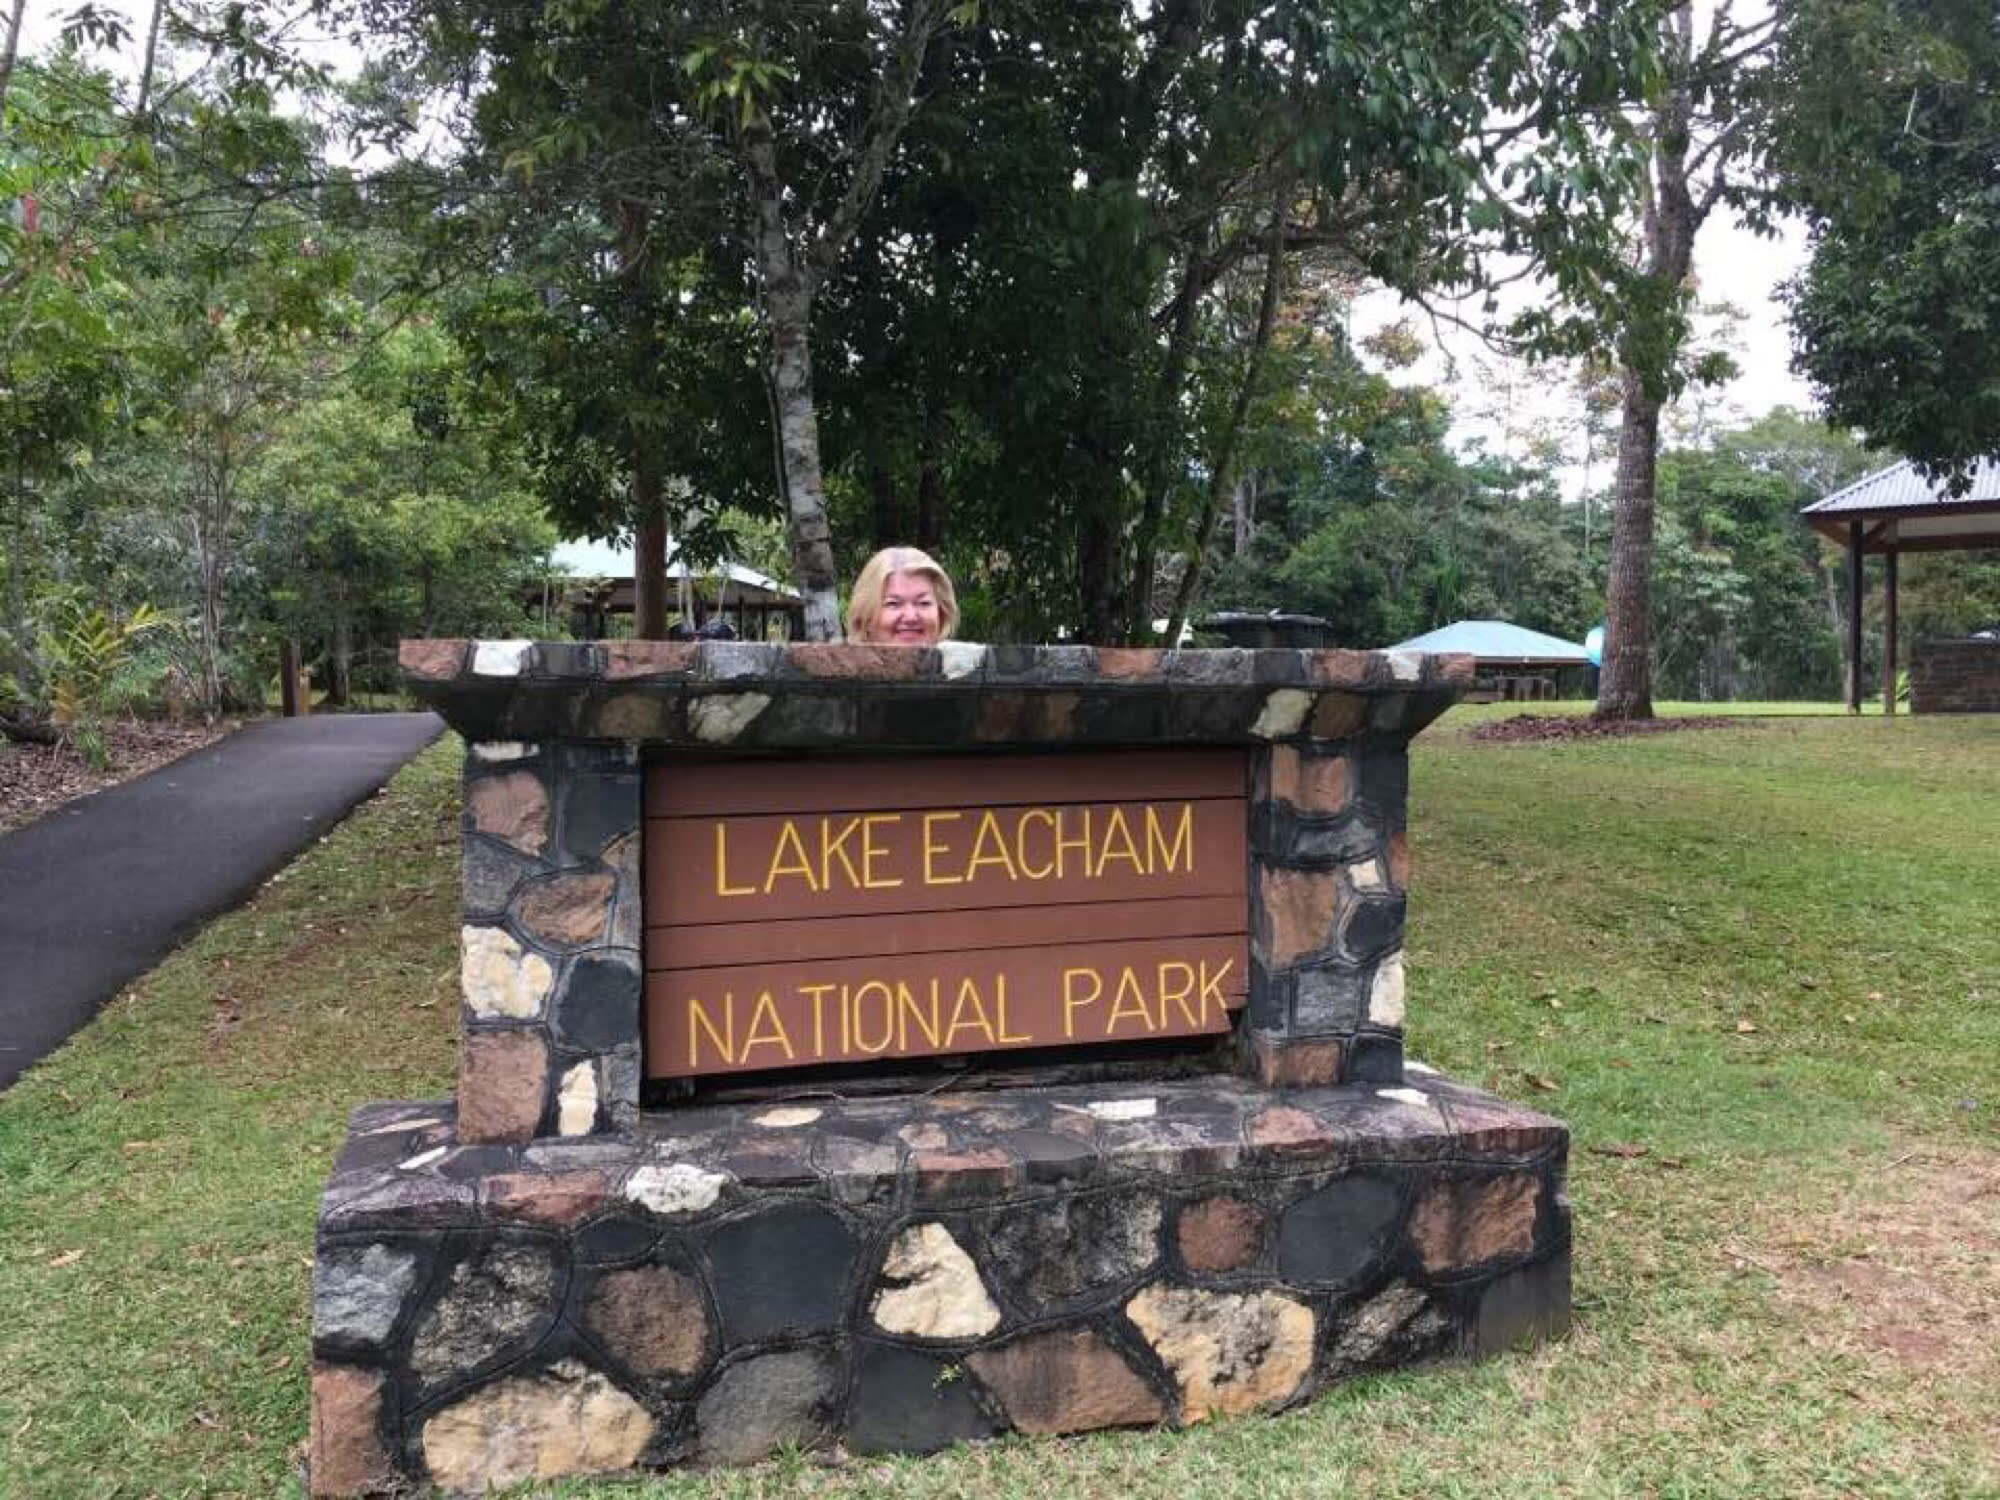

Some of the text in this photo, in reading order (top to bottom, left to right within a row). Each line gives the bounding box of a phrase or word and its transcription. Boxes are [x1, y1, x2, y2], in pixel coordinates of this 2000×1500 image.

[715, 803, 1194, 898] LAKE EACHAM
[688, 957, 1235, 1068] NATIONAL PARK
